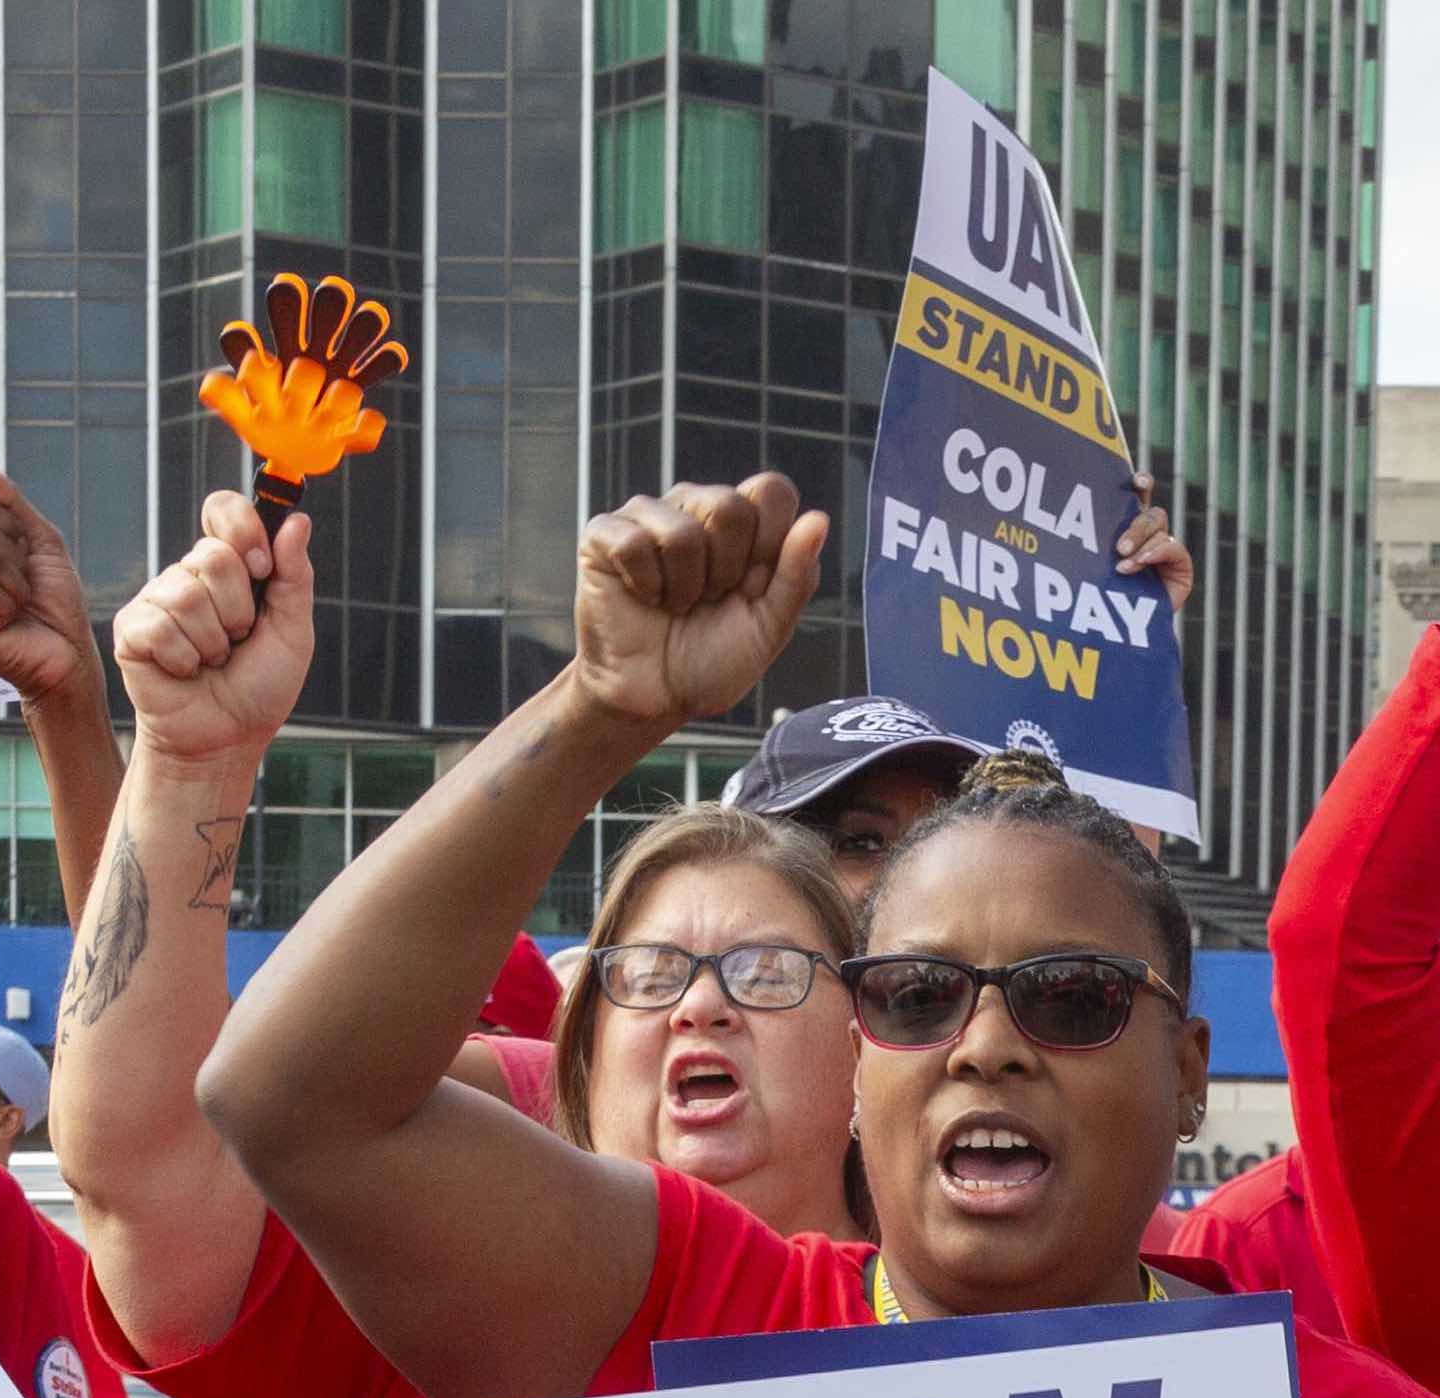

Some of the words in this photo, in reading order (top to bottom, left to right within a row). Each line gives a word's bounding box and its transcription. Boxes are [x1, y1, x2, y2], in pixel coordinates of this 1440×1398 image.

[967, 119, 1083, 337] UA
[916, 296, 1081, 414] STAND
[944, 429, 1098, 552] COLA
[994, 518, 1039, 555] AND
[882, 497, 1020, 610] FAIR
[1035, 563, 1157, 647] PAY
[941, 601, 1097, 697] NOW
